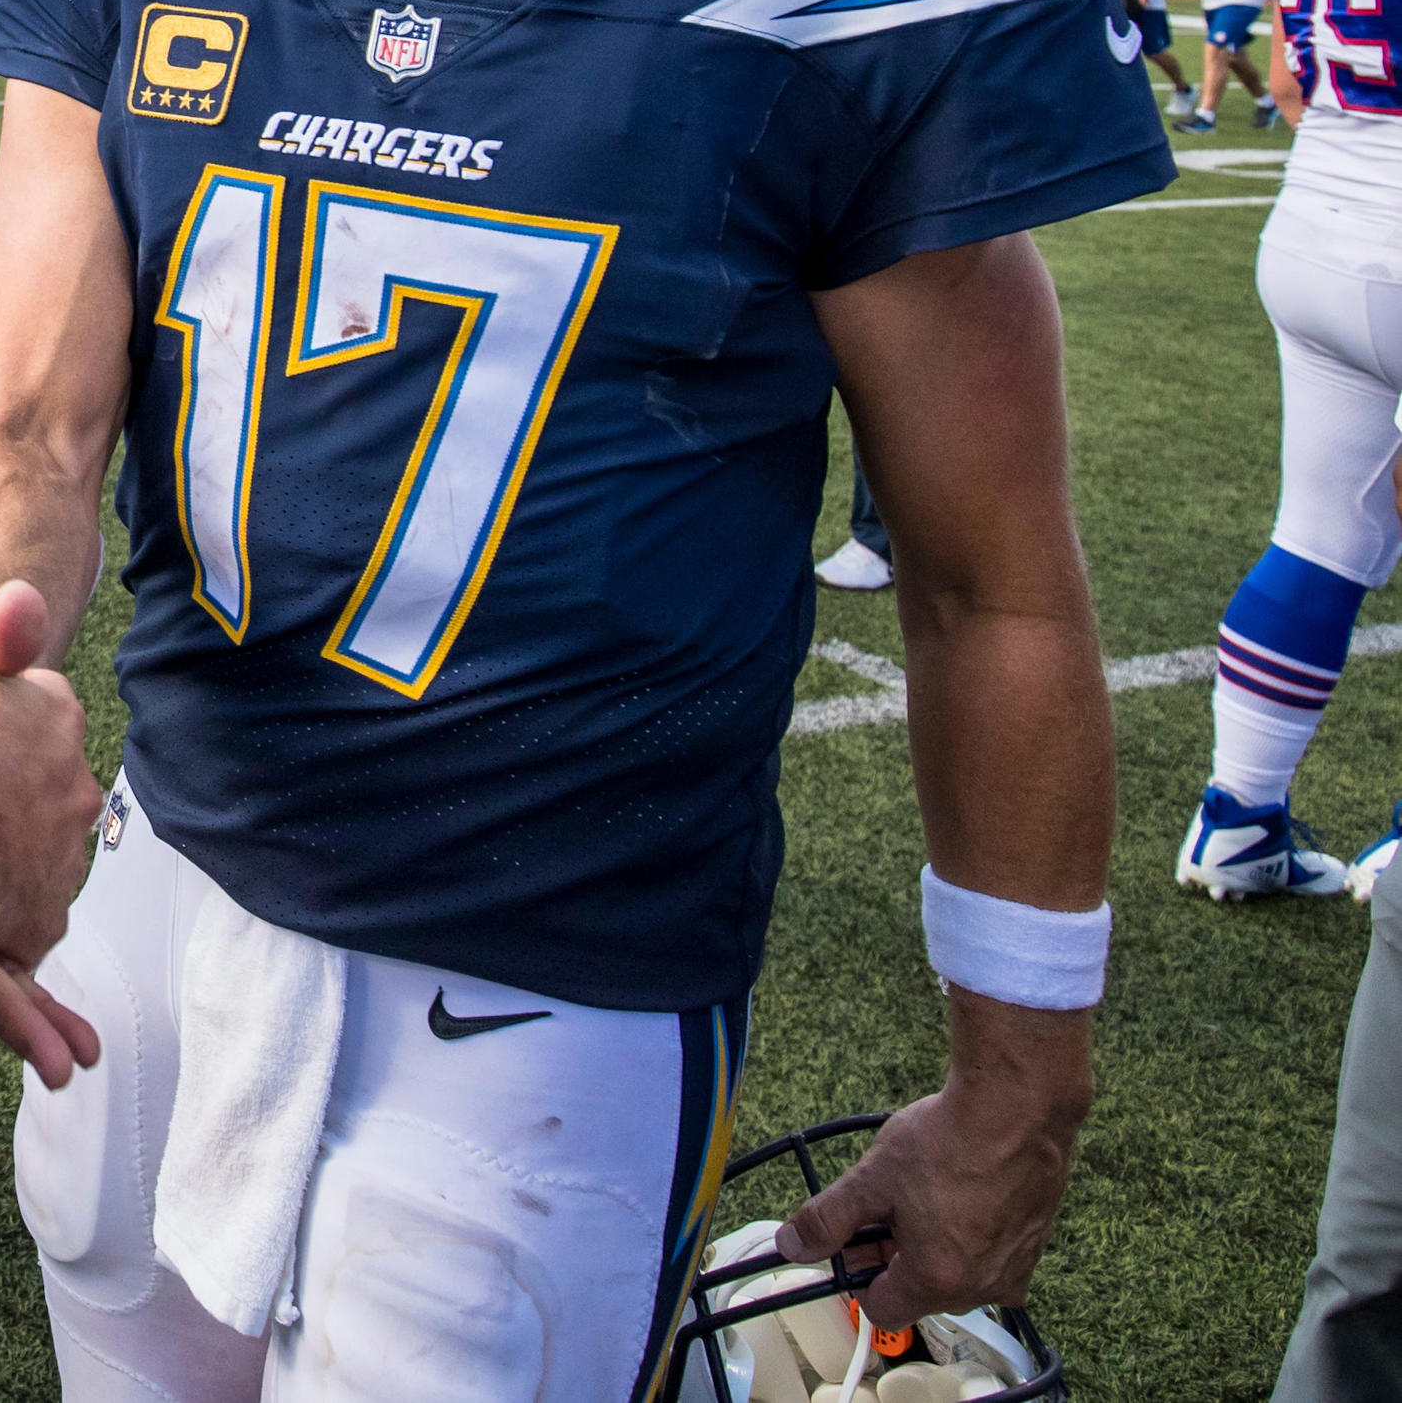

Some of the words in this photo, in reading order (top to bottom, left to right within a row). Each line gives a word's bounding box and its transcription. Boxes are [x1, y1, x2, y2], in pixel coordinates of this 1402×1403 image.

[142, 14, 234, 91] C
[378, 37, 423, 68] NFL
[258, 111, 504, 181] CHARGERS
[153, 161, 621, 700] 17
